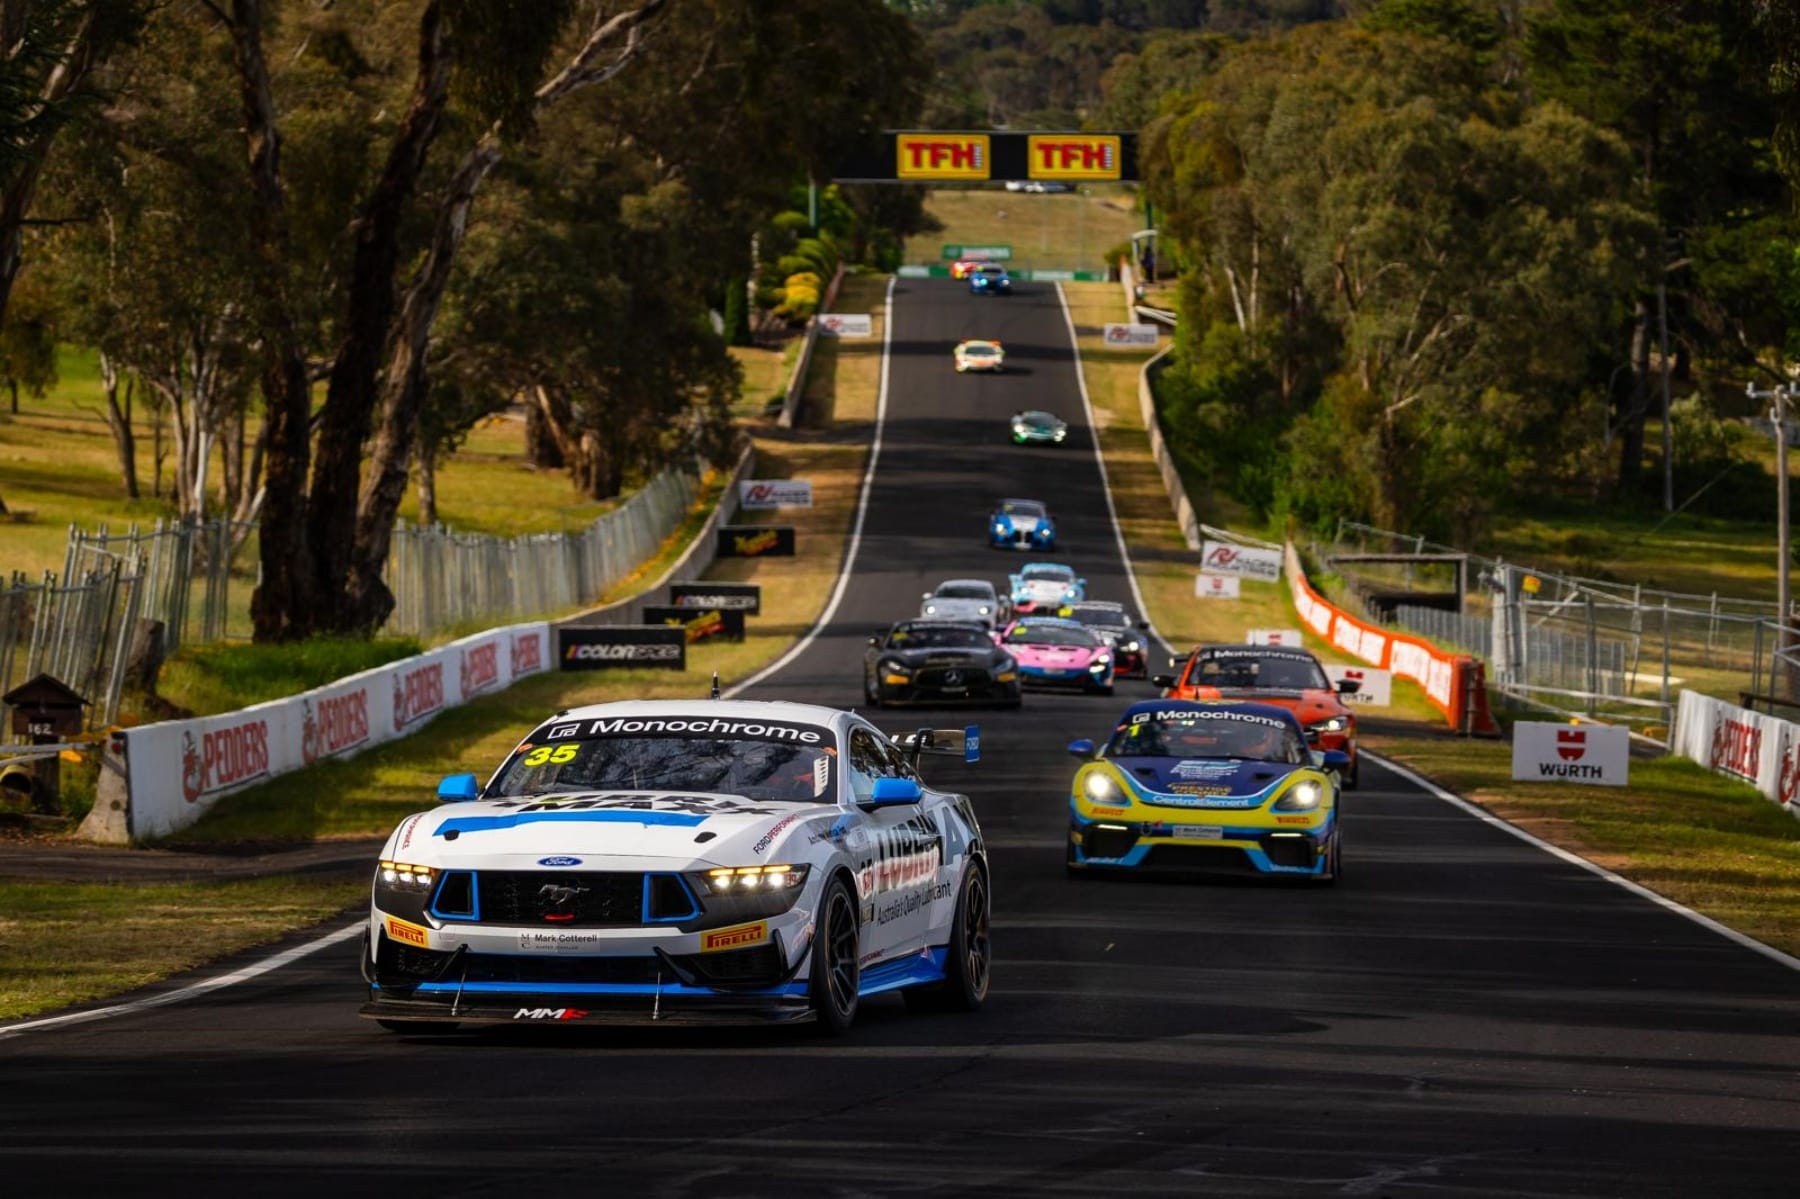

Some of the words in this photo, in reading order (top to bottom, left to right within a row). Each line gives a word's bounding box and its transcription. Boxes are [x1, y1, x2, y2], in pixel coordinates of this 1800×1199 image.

[906, 142, 976, 169] TFH
[1037, 142, 1107, 169] TFH
[403, 662, 443, 721] PEDDERS
[28, 723, 52, 735] 162
[317, 688, 370, 755] PEDDERS
[590, 719, 821, 743] Monochrome
[1129, 724, 1141, 737] 1
[1156, 711, 1287, 729] Monochrome
[202, 720, 270, 788] PEDDERS
[524, 744, 580, 767] 35
[1539, 762, 1603, 779] WÜRTH
[390, 921, 425, 945] PIRELLI
[534, 934, 557, 942] Mark
[558, 934, 598, 943] Cotterell
[707, 926, 763, 949] PIRELLI
